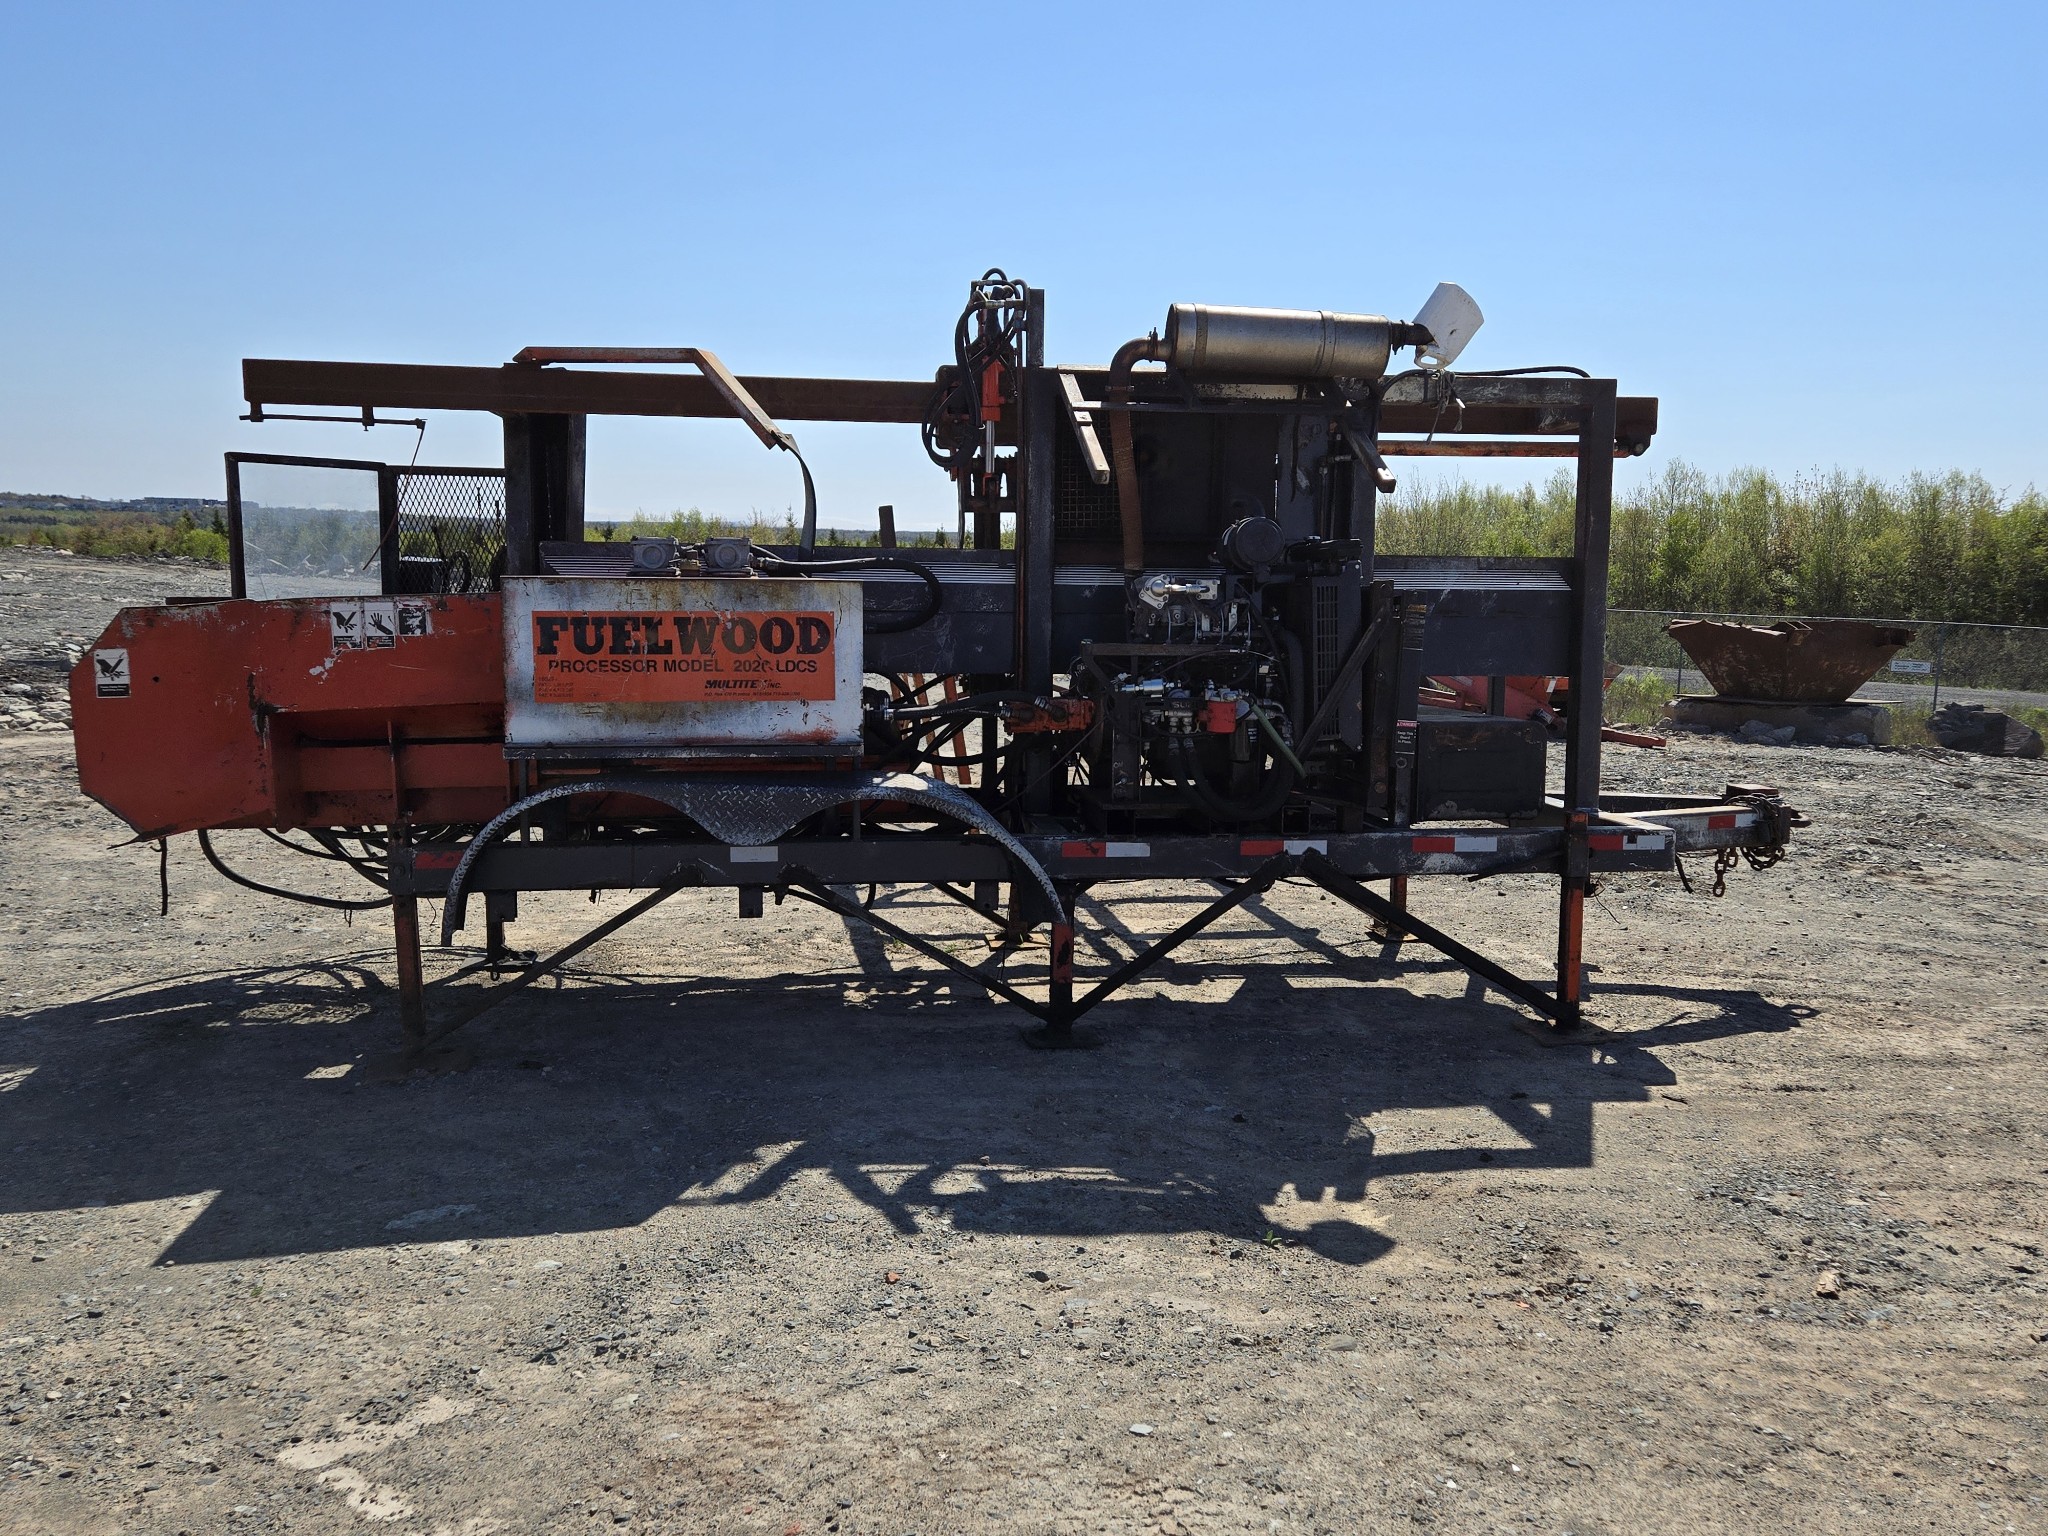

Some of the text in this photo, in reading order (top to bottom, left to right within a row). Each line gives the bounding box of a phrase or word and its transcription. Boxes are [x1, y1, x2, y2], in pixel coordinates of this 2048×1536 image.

[535, 616, 831, 655] FUELWOOD
[548, 659, 658, 673] PROCESSOR
[663, 659, 724, 673] MODEL
[776, 659, 818, 673] LDCS
